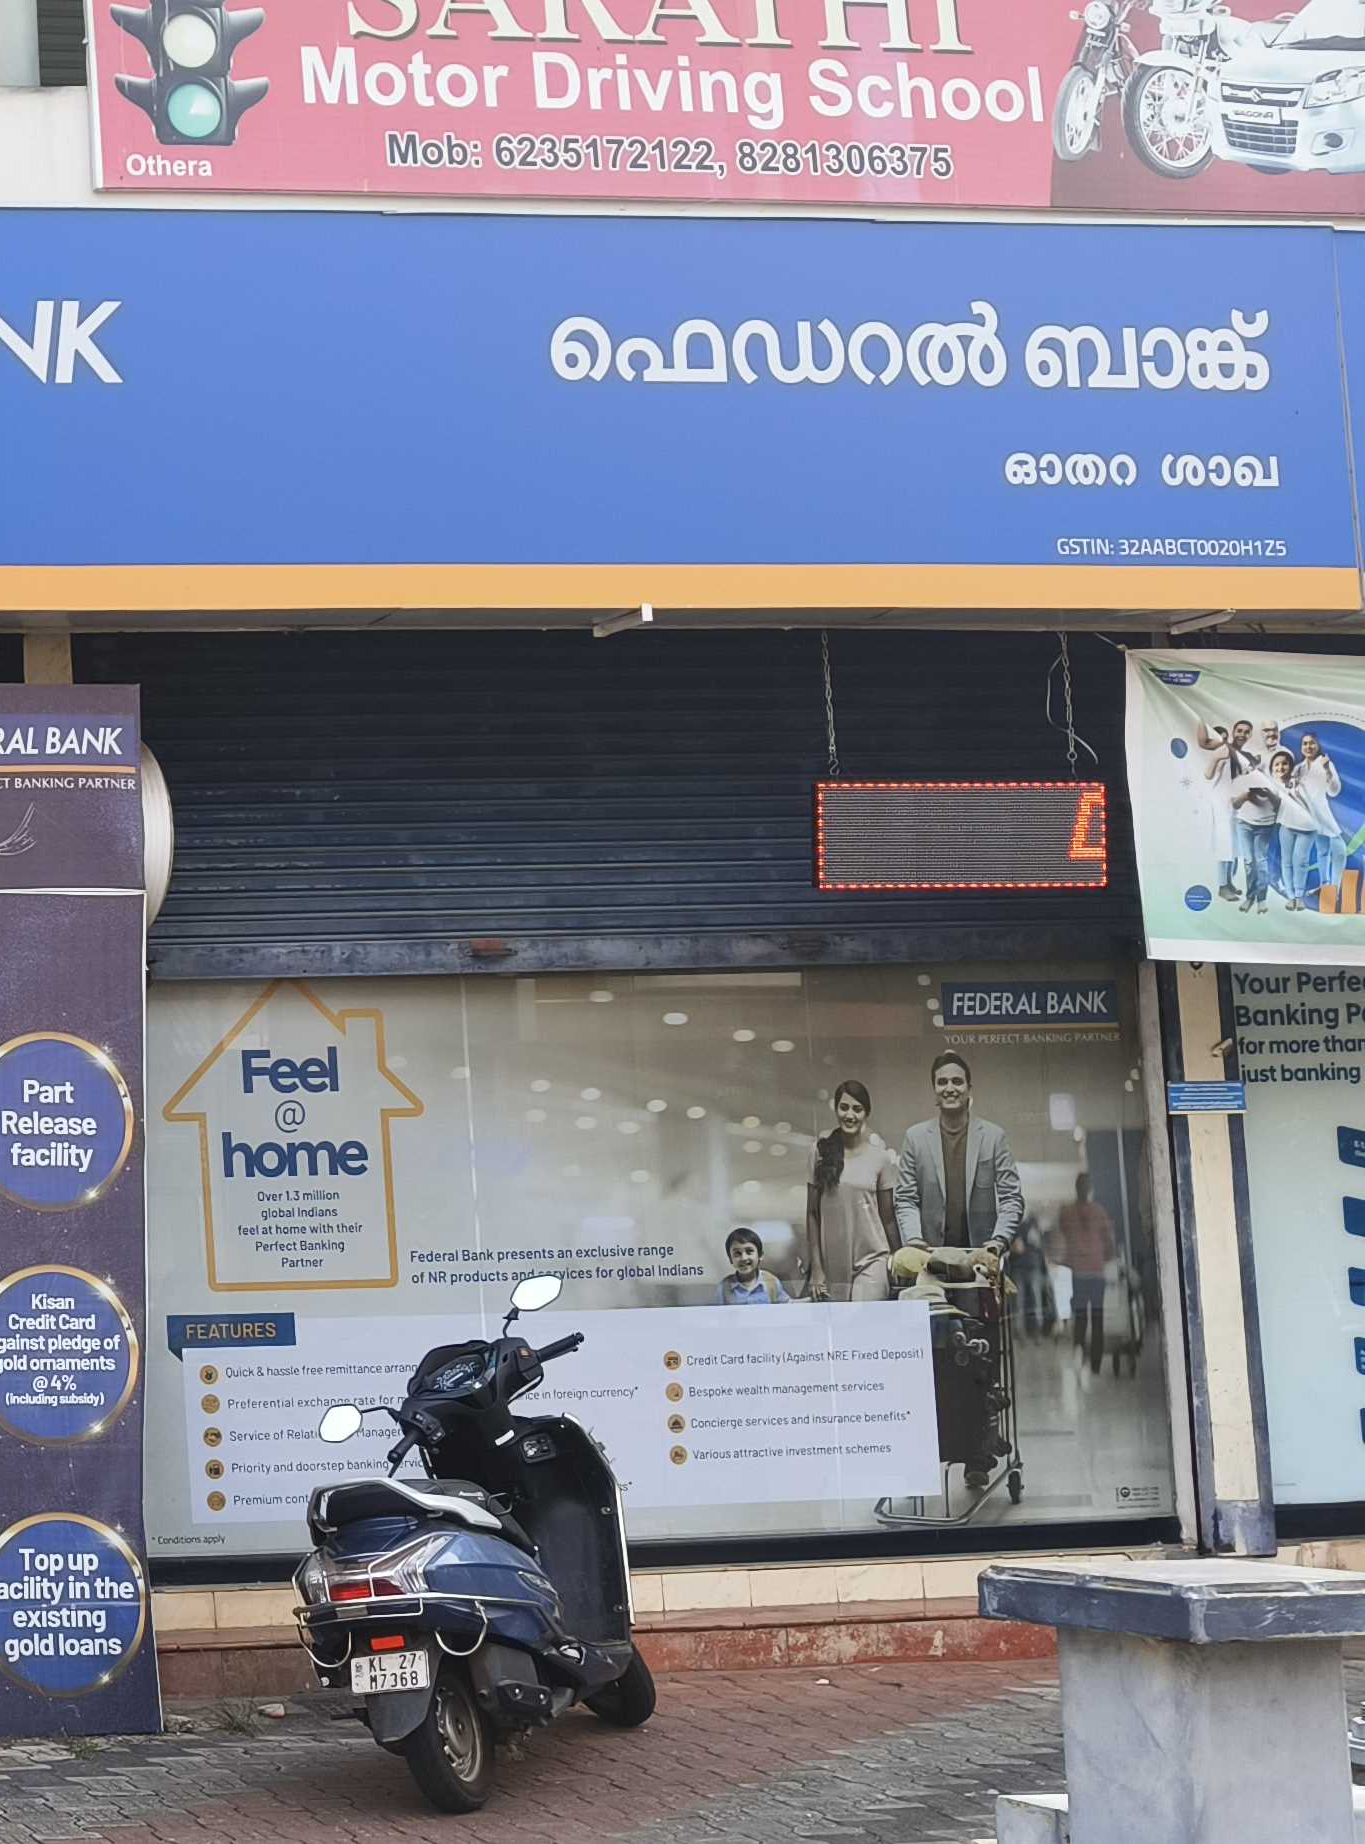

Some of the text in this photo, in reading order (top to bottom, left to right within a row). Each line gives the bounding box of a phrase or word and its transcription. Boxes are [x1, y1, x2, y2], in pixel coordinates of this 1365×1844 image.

[300, 45, 1045, 130] Motor Driving School
[125, 153, 213, 178] Othera
[386, 132, 955, 179] Mob: 6235172122, 8281306375
[550, 301, 1271, 391] ഫെഡറൽ ബാങ്ക്
[1004, 452, 1280, 488] ഓതറ ശാഖ
[1056, 538, 1115, 556] GSTIN:
[45, 726, 123, 756] BANK
[14, 777, 75, 789] BANKING
[77, 778, 137, 791] PARTNER
[1233, 972, 1291, 995] Your
[951, 990, 1108, 1016] FEDERAL BANK
[1235, 1002, 1339, 1030] Banking
[1237, 1036, 1321, 1055] for more
[241, 1045, 340, 1094] Feel
[1240, 1061, 1361, 1085] just banking
[22, 1079, 74, 1105] Part
[0, 1110, 98, 1136] Release
[10, 1141, 94, 1173] facility
[220, 1131, 369, 1179] home
[257, 1189, 340, 1202] Over 1.3 million
[261, 1206, 338, 1220] global Indians
[410, 1245, 674, 1264] Federal Bank presents an exclusive range
[31, 1293, 75, 1311] Kisan
[8, 1313, 96, 1331] Credit Card
[185, 1321, 277, 1341] FEATURES
[689, 1380, 885, 1399] Bespoke wealth management services
[157, 1534, 226, 1545] Conditions apply
[18, 1548, 99, 1577] Top up
[68, 1575, 91, 1600] in
[94, 1576, 135, 1600] the
[12, 1603, 107, 1633] existing
[4, 1632, 123, 1663] gold loans
[368, 1656, 387, 1673] KL
[398, 1652, 417, 1670] 27
[369, 1669, 419, 1690] M7368
